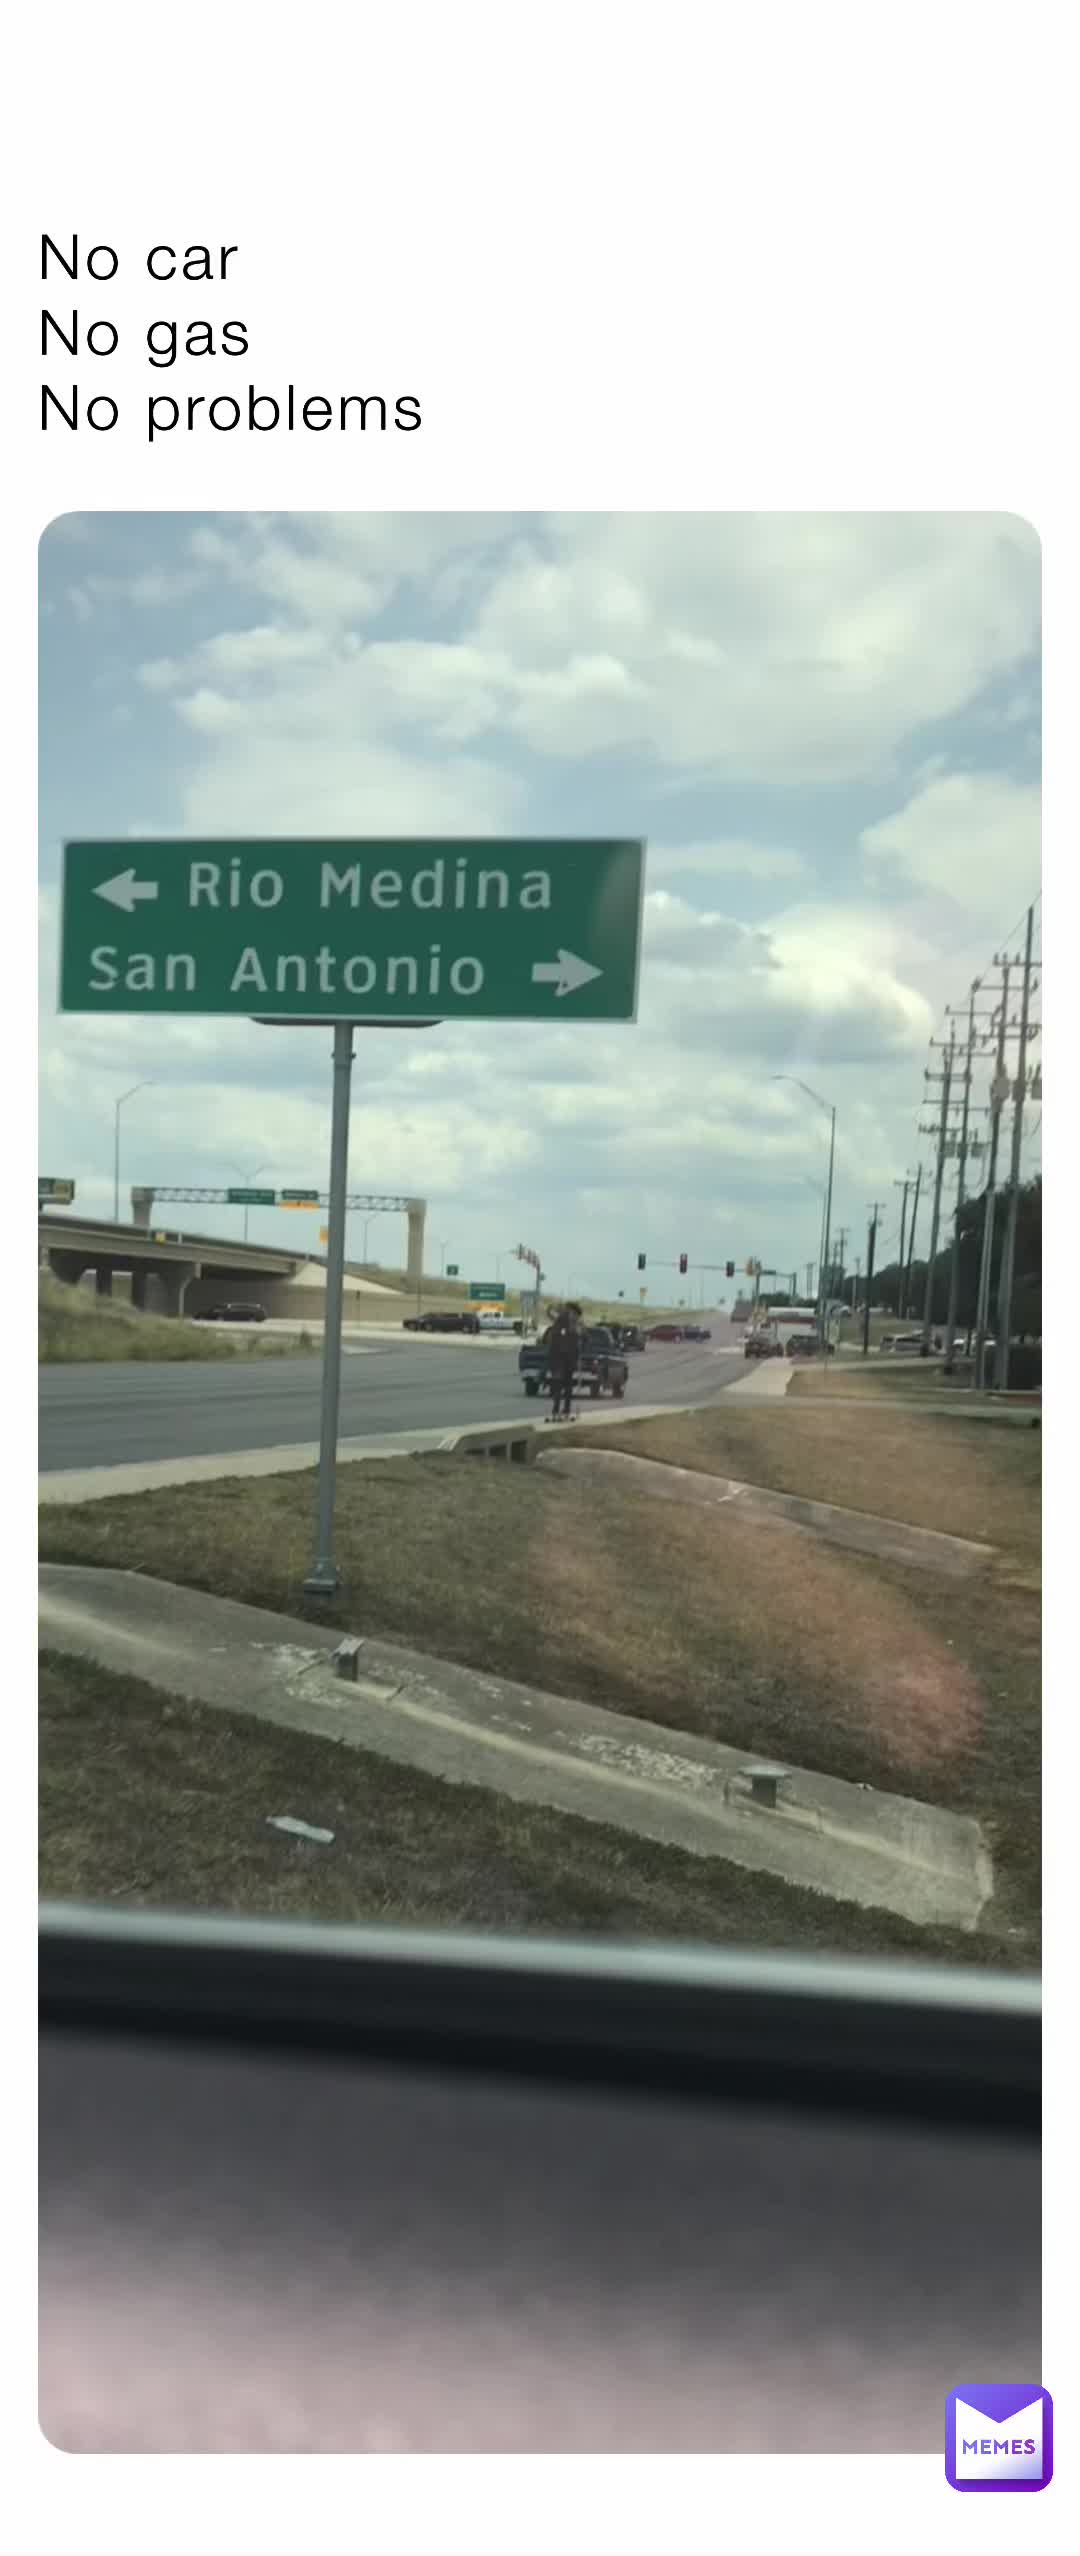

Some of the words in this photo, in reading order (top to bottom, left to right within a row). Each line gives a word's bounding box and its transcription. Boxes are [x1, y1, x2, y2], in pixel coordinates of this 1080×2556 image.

[188, 859, 284, 908] Rio
[319, 858, 552, 910] Medina
[88, 945, 197, 992] San
[230, 944, 485, 995] Antonio
